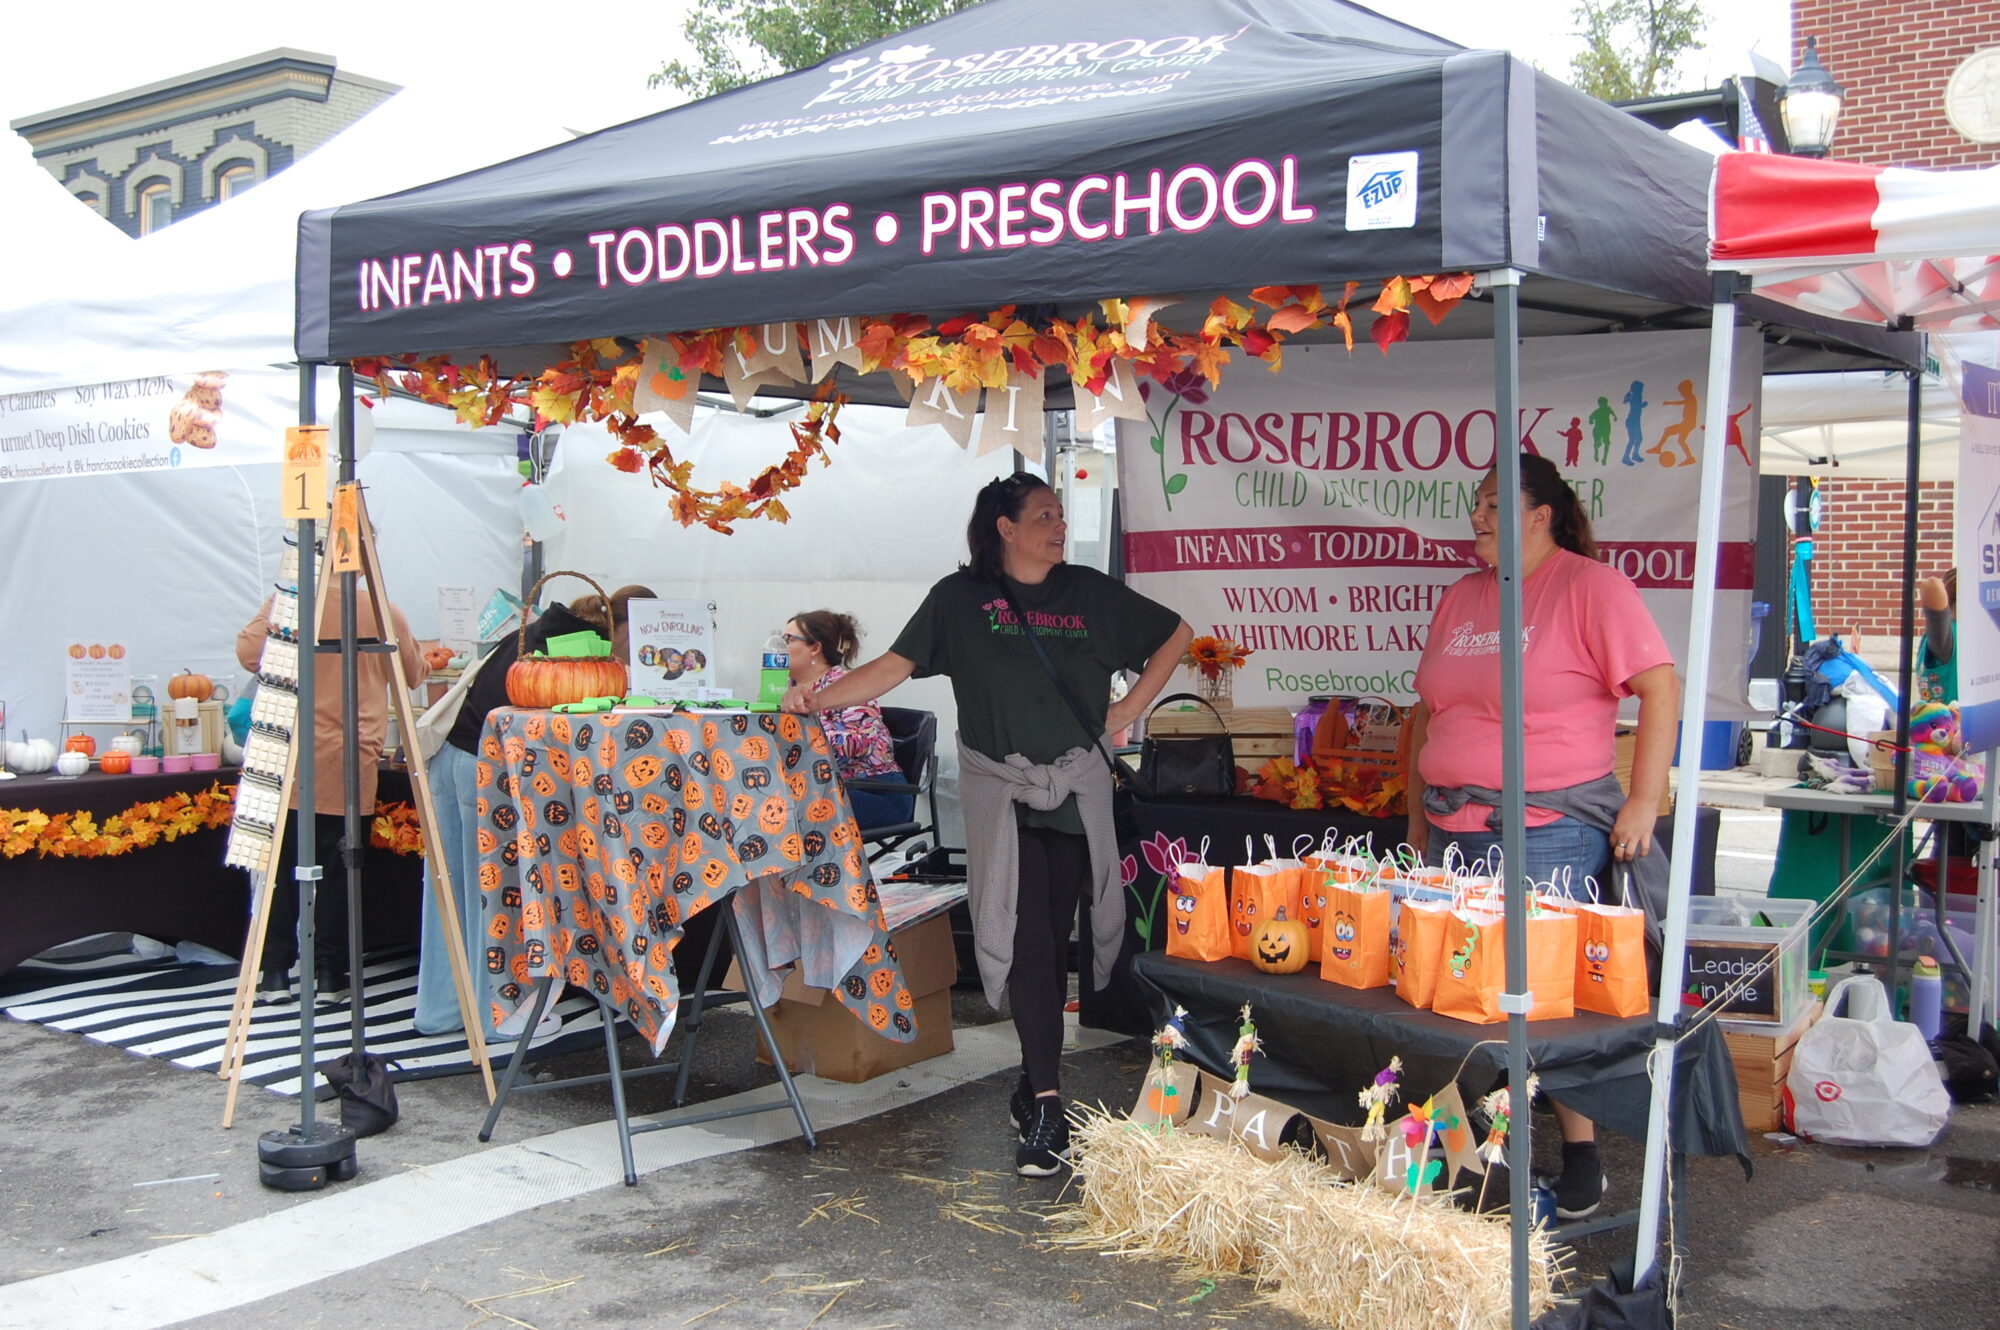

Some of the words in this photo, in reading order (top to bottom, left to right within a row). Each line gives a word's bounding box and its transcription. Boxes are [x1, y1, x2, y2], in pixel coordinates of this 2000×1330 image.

[852, 22, 1252, 91] ROSEBROOK
[839, 81, 915, 105] CHILD
[917, 60, 1108, 95] DEVELOPMENT
[1110, 51, 1222, 73] CENTER
[360, 240, 537, 312] INFANTS
[588, 203, 856, 289] TODDLERS
[920, 153, 1316, 256] PRESCHOOL
[0, 430, 34, 453] urmet
[36, 427, 65, 451] Deep
[67, 420, 95, 446] Dish
[98, 417, 150, 444] Cookies
[294, 471, 311, 511] 1
[1235, 470, 1307, 509] CHILD
[1323, 476, 1484, 520] DEVELOPMEN
[1175, 533, 1286, 565] INFANTS
[1222, 586, 1319, 613] WIXOM
[661, 620, 705, 637] ENROLLING
[996, 609, 1087, 630] ROEBROOK
[1365, 624, 1431, 652] LAK
[1265, 667, 1416, 695] RosebrookC
[1701, 981, 1717, 1000] in
[1725, 981, 1758, 1002] Me
